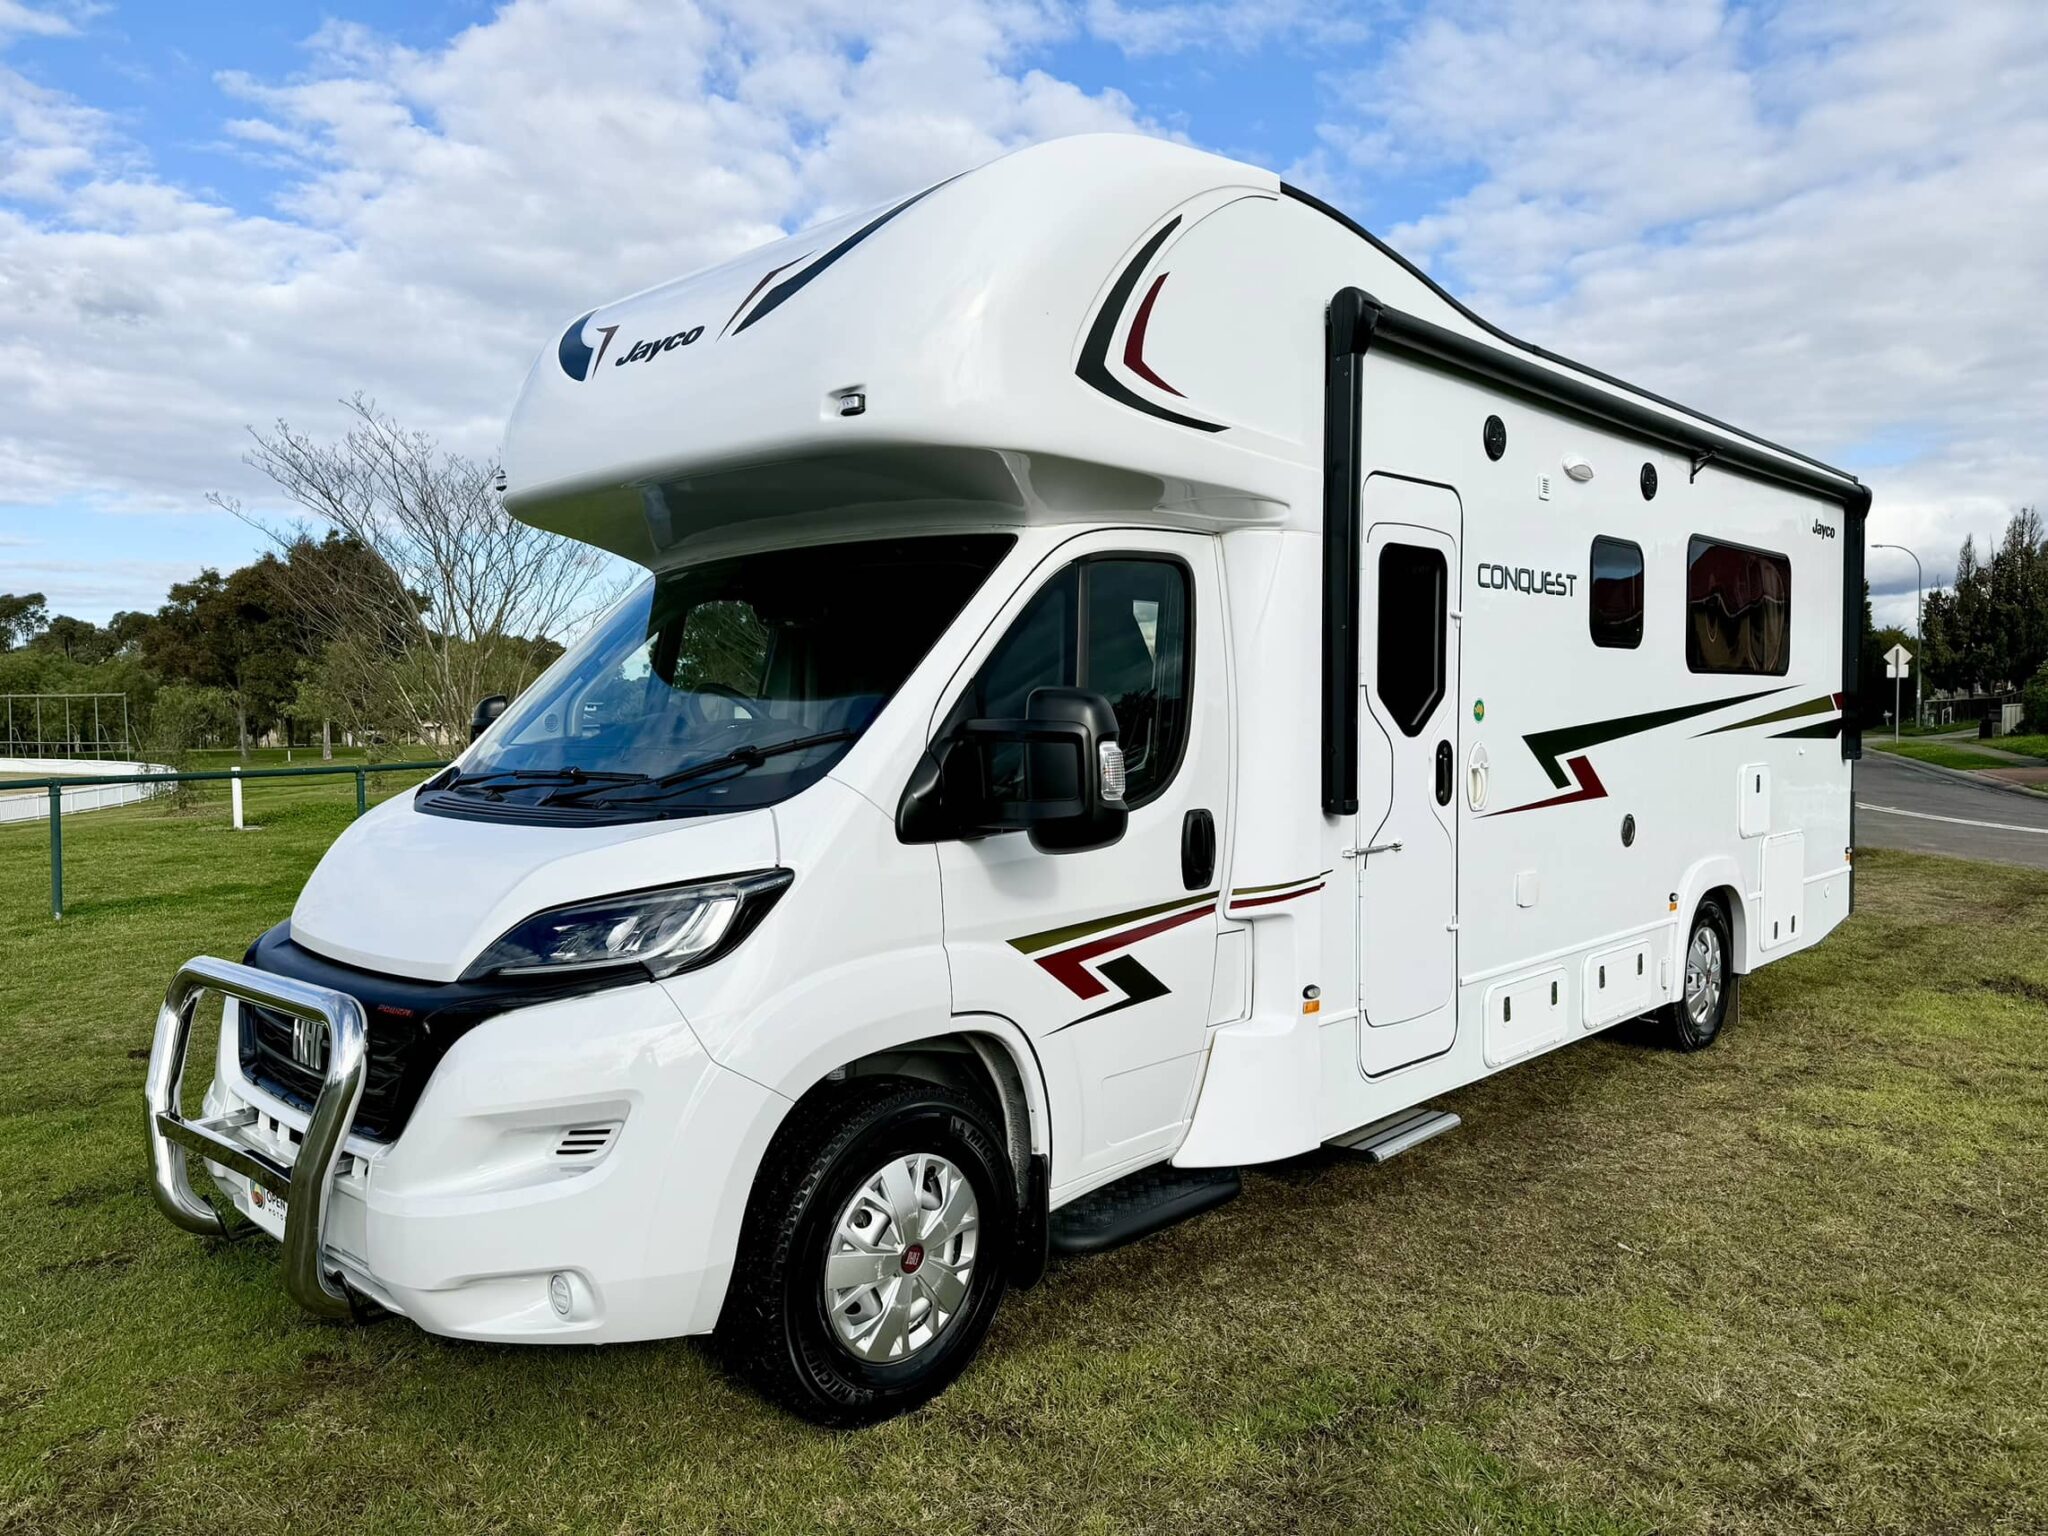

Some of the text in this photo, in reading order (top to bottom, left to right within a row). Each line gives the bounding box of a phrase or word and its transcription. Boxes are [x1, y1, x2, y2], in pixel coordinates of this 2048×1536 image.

[615, 325, 705, 367] Jayco
[1812, 518, 1836, 540] Jayco
[1477, 563, 1578, 597] CONQUEST
